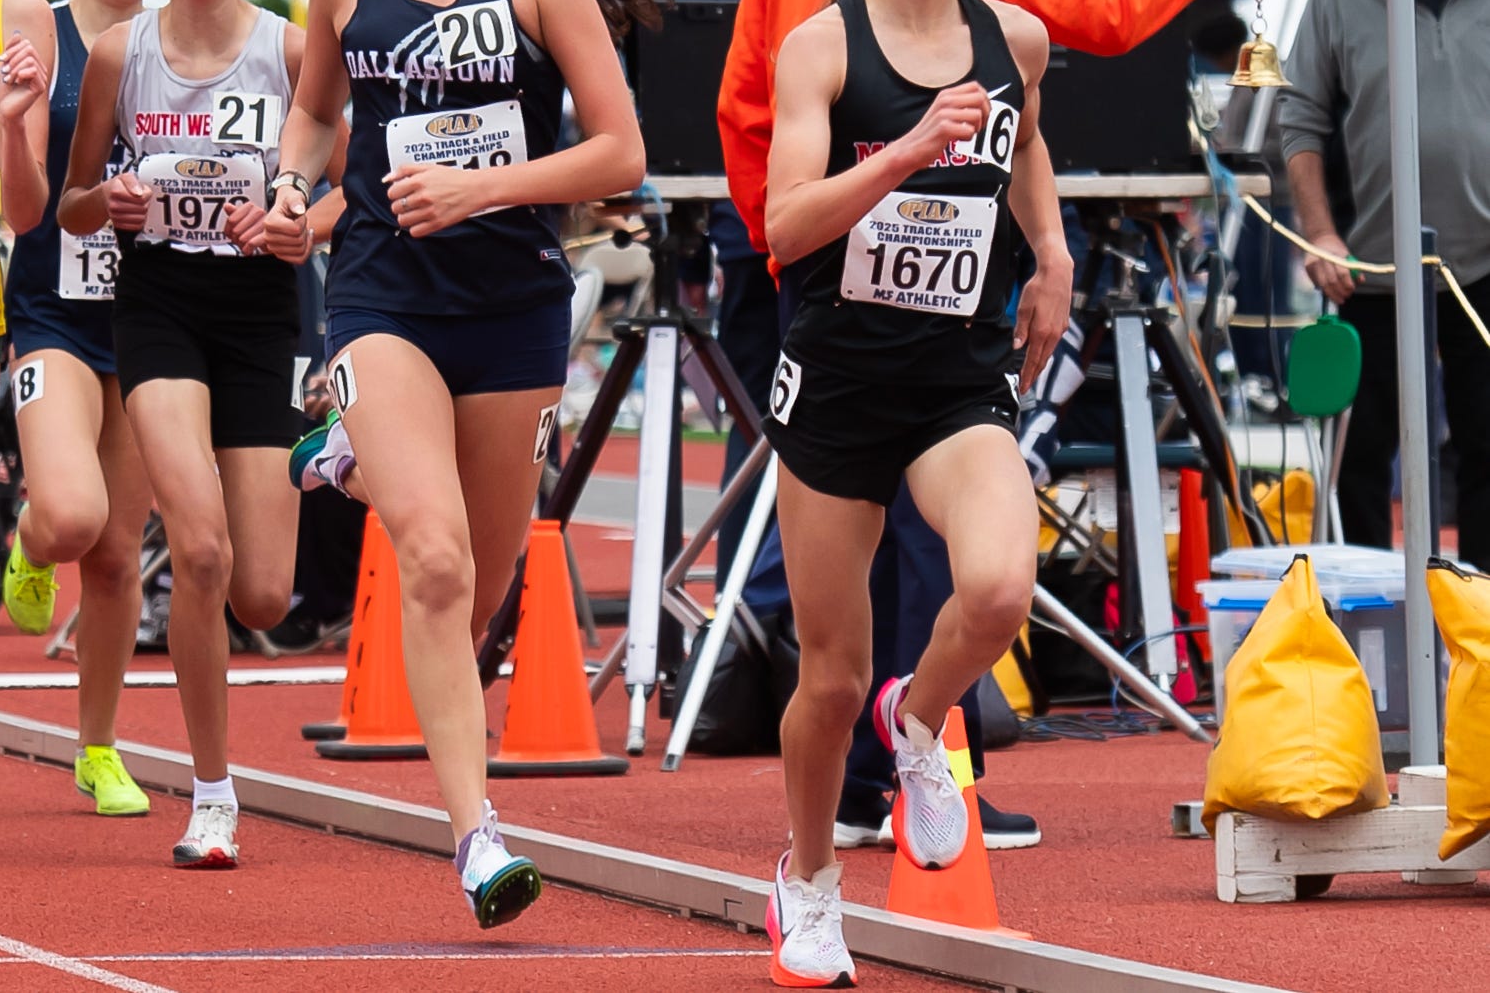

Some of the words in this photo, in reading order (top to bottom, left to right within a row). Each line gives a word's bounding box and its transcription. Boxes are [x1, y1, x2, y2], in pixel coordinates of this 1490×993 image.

[441, 7, 504, 66] 20
[135, 112, 181, 136] SOUTH
[218, 95, 267, 143] 21
[434, 114, 480, 135] PIAA
[405, 143, 432, 154] 2025
[435, 138, 470, 149] TRACK
[483, 130, 510, 143] FIELD
[414, 141, 503, 162] CHAMPIONSHIPS
[184, 158, 224, 176] PIAA
[153, 178, 179, 186] 2025
[181, 179, 213, 187] TRACK
[225, 179, 251, 187] FIELD
[161, 187, 243, 195] CHAMPIONSHIPS
[904, 200, 957, 222] PIAA
[186, 230, 227, 240] ATHLET
[870, 220, 899, 232] 2025
[903, 224, 940, 236] TRACK
[943, 228, 951, 237] &
[954, 228, 982, 238] FIELD
[877, 232, 974, 248] CHAMPIONSHIPS
[75, 249, 118, 284] 13
[866, 243, 979, 295] 1670
[896, 290, 961, 309] ATHLETIC
[774, 361, 793, 416] 6
[535, 410, 553, 461] 2
